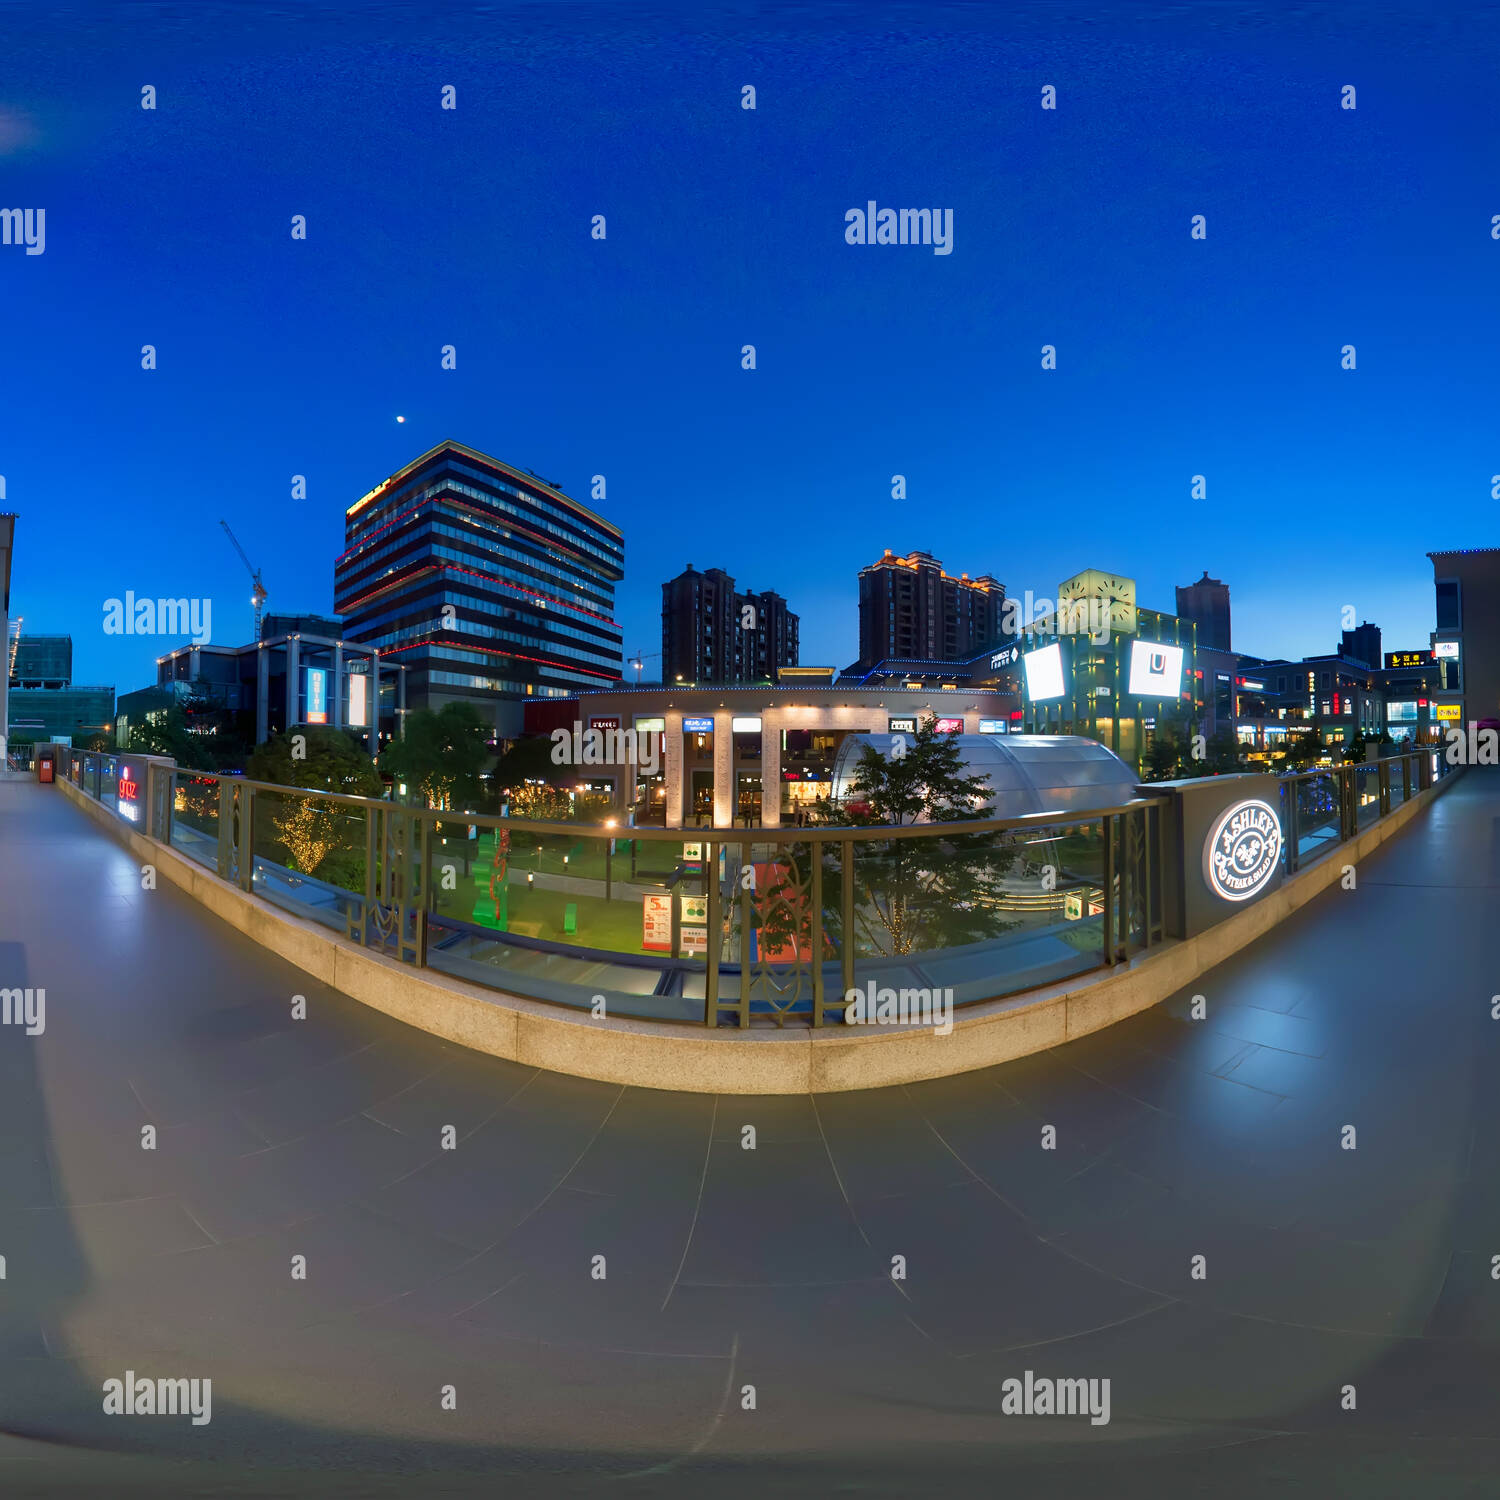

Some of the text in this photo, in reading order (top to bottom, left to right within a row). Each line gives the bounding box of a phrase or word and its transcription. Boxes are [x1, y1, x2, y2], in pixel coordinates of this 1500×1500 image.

[1152, 653, 1165, 671] U
[1222, 808, 1274, 854] ASHLEY
[1225, 874, 1248, 889] STEAK
[1253, 857, 1271, 883] SALAD
